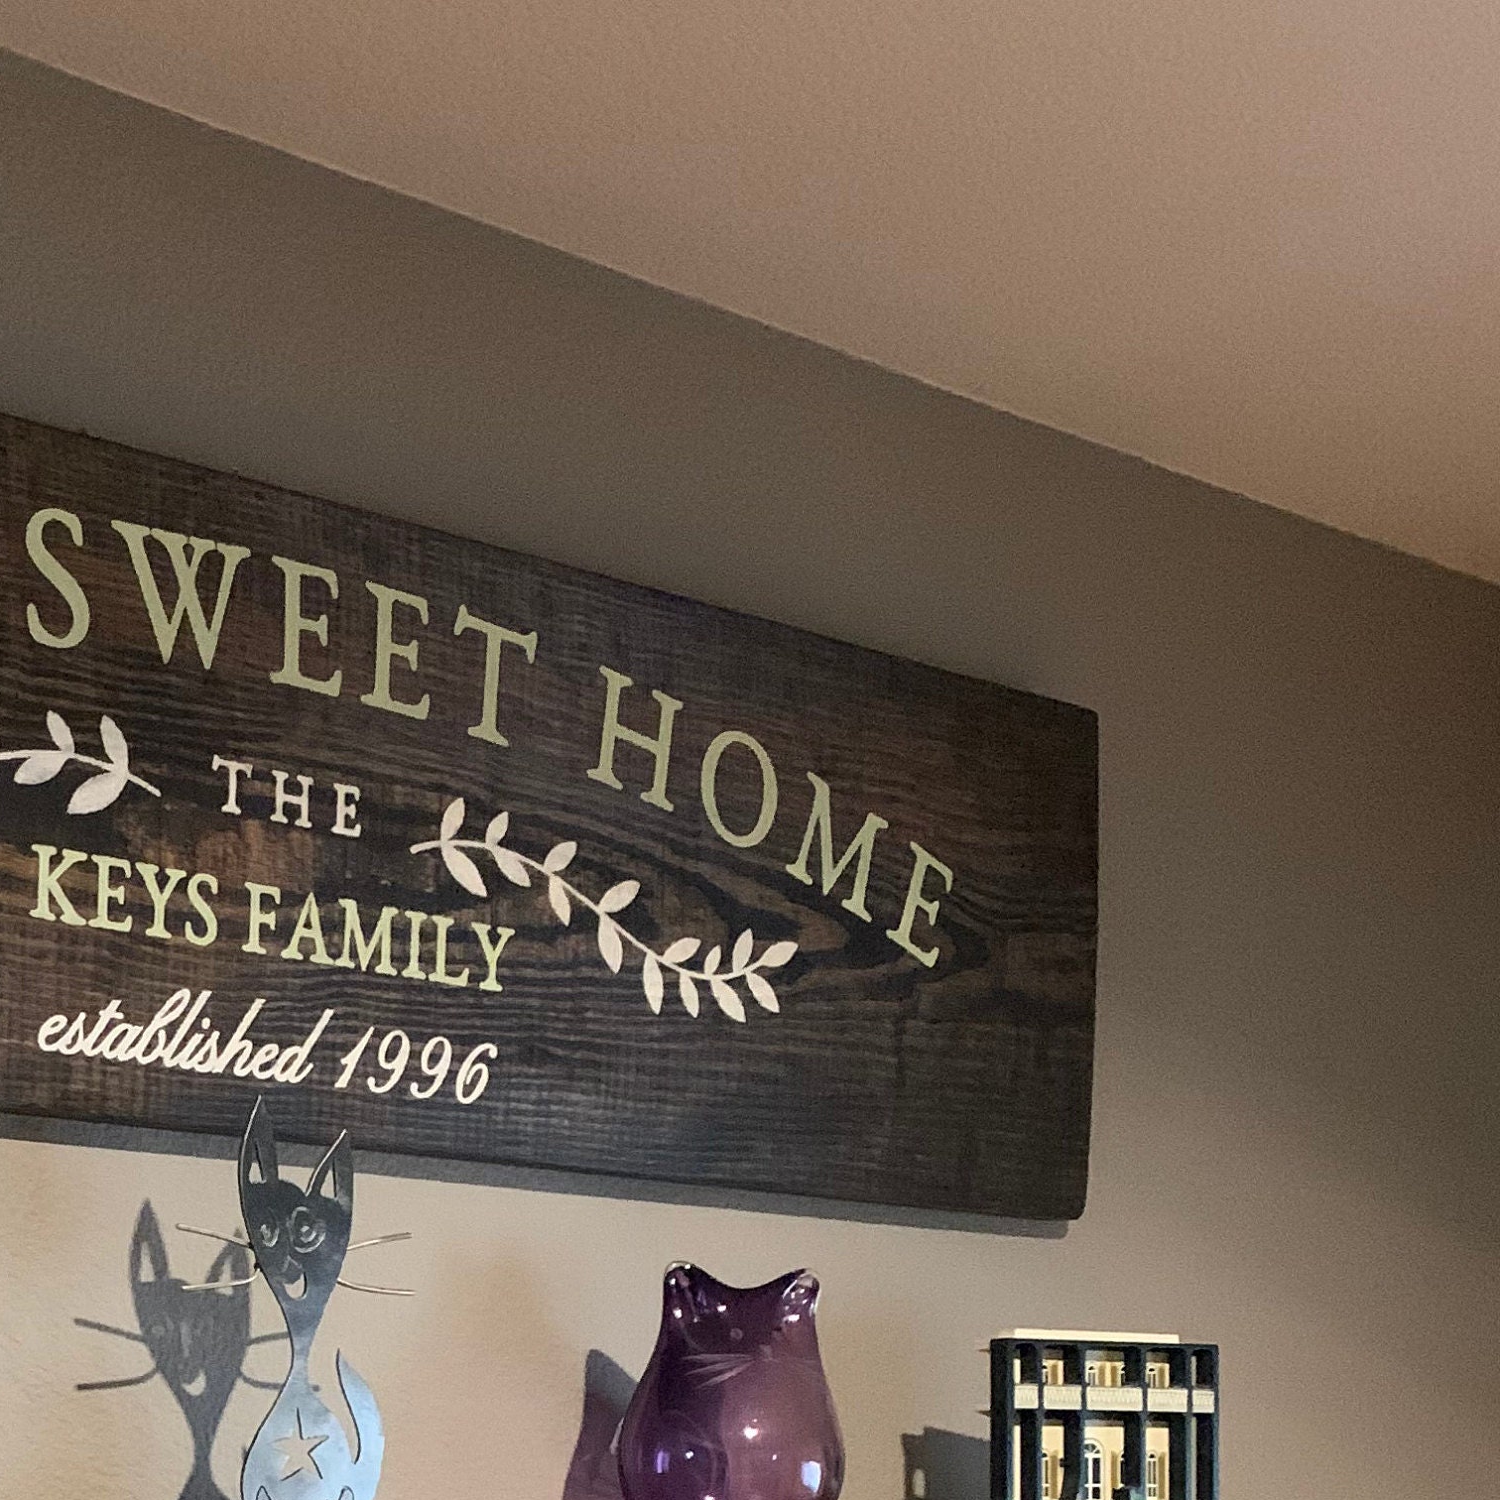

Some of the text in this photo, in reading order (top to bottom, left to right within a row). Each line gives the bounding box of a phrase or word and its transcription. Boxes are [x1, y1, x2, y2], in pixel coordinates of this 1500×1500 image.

[25, 507, 538, 747] SWEET
[586, 665, 954, 968] HOME
[211, 754, 363, 839] THE
[28, 843, 516, 993] KEYS FAMILY
[36, 987, 499, 1105] established 1996
